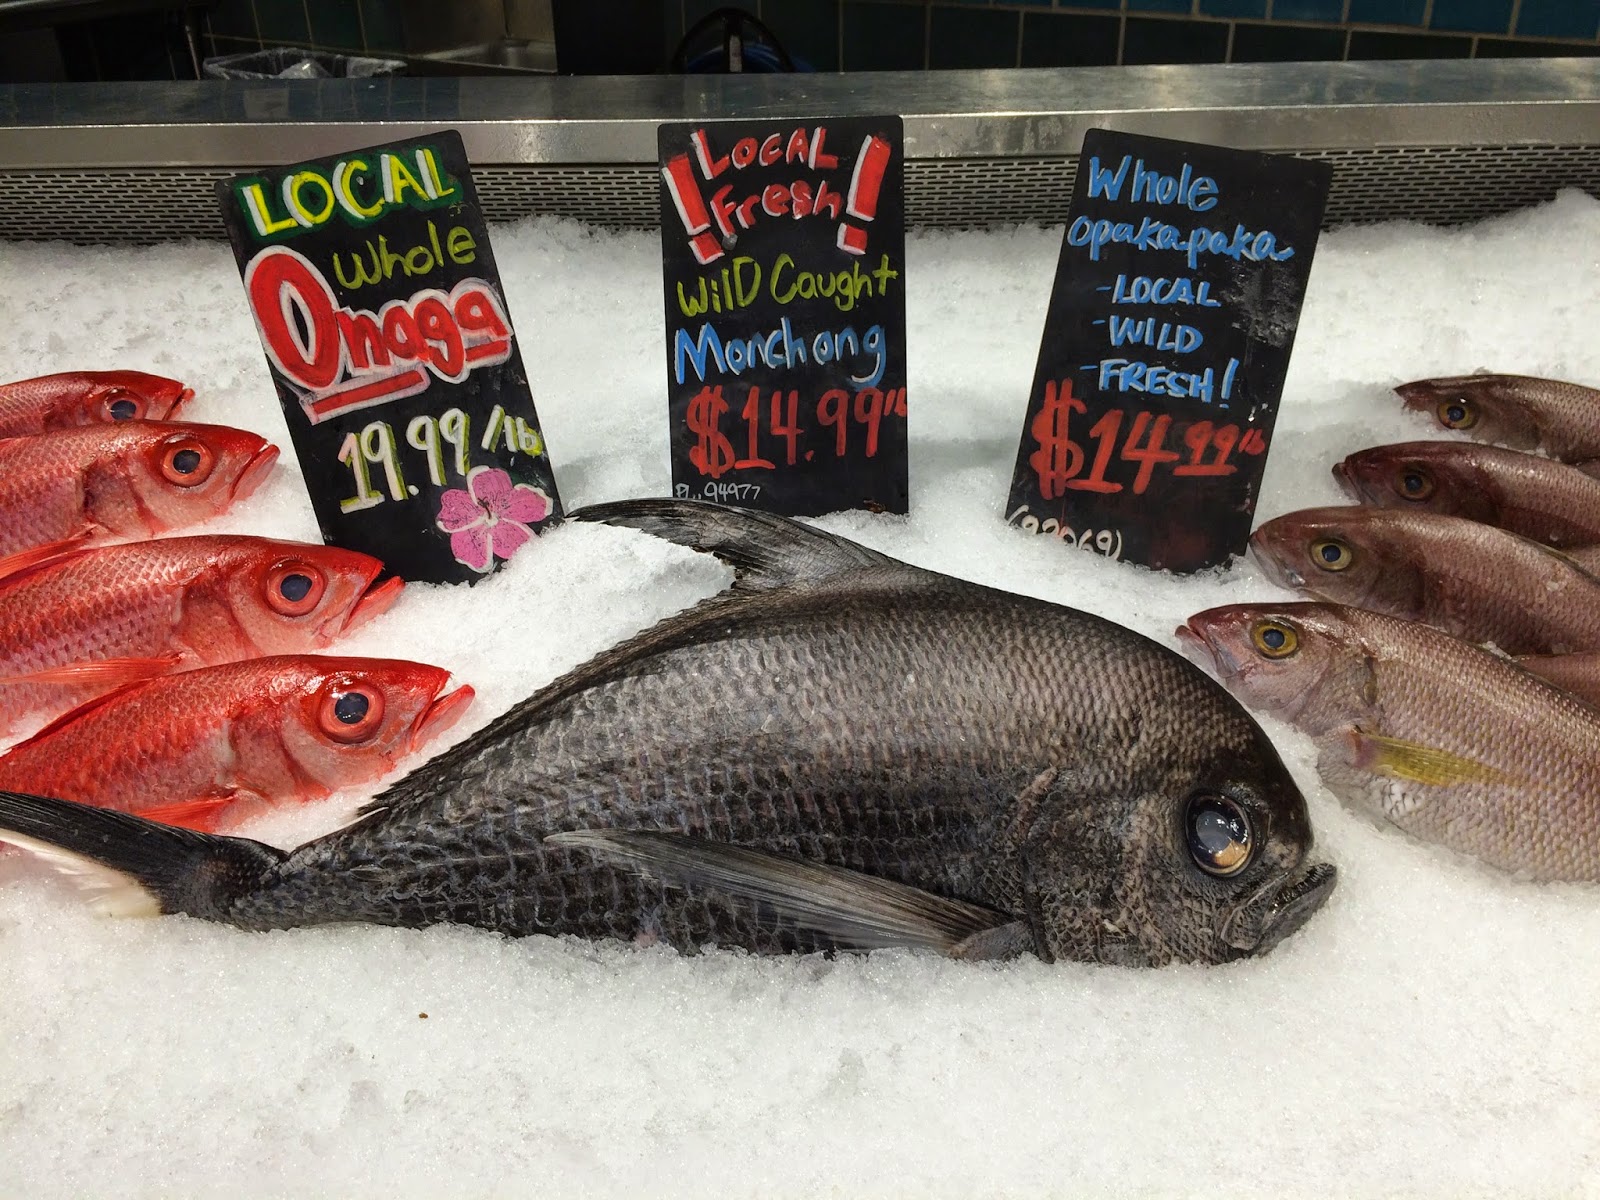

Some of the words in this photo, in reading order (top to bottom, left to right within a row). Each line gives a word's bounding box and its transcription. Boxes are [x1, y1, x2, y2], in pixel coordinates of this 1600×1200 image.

[242, 149, 455, 236] LOCAL
[710, 180, 842, 238] Fresh
[1087, 155, 1219, 212] Whole
[770, 253, 898, 312] Caught
[245, 246, 512, 391] Onaga
[675, 316, 886, 392] Monchong
[339, 408, 470, 513] 19.99
[704, 482, 760, 502] 94977
